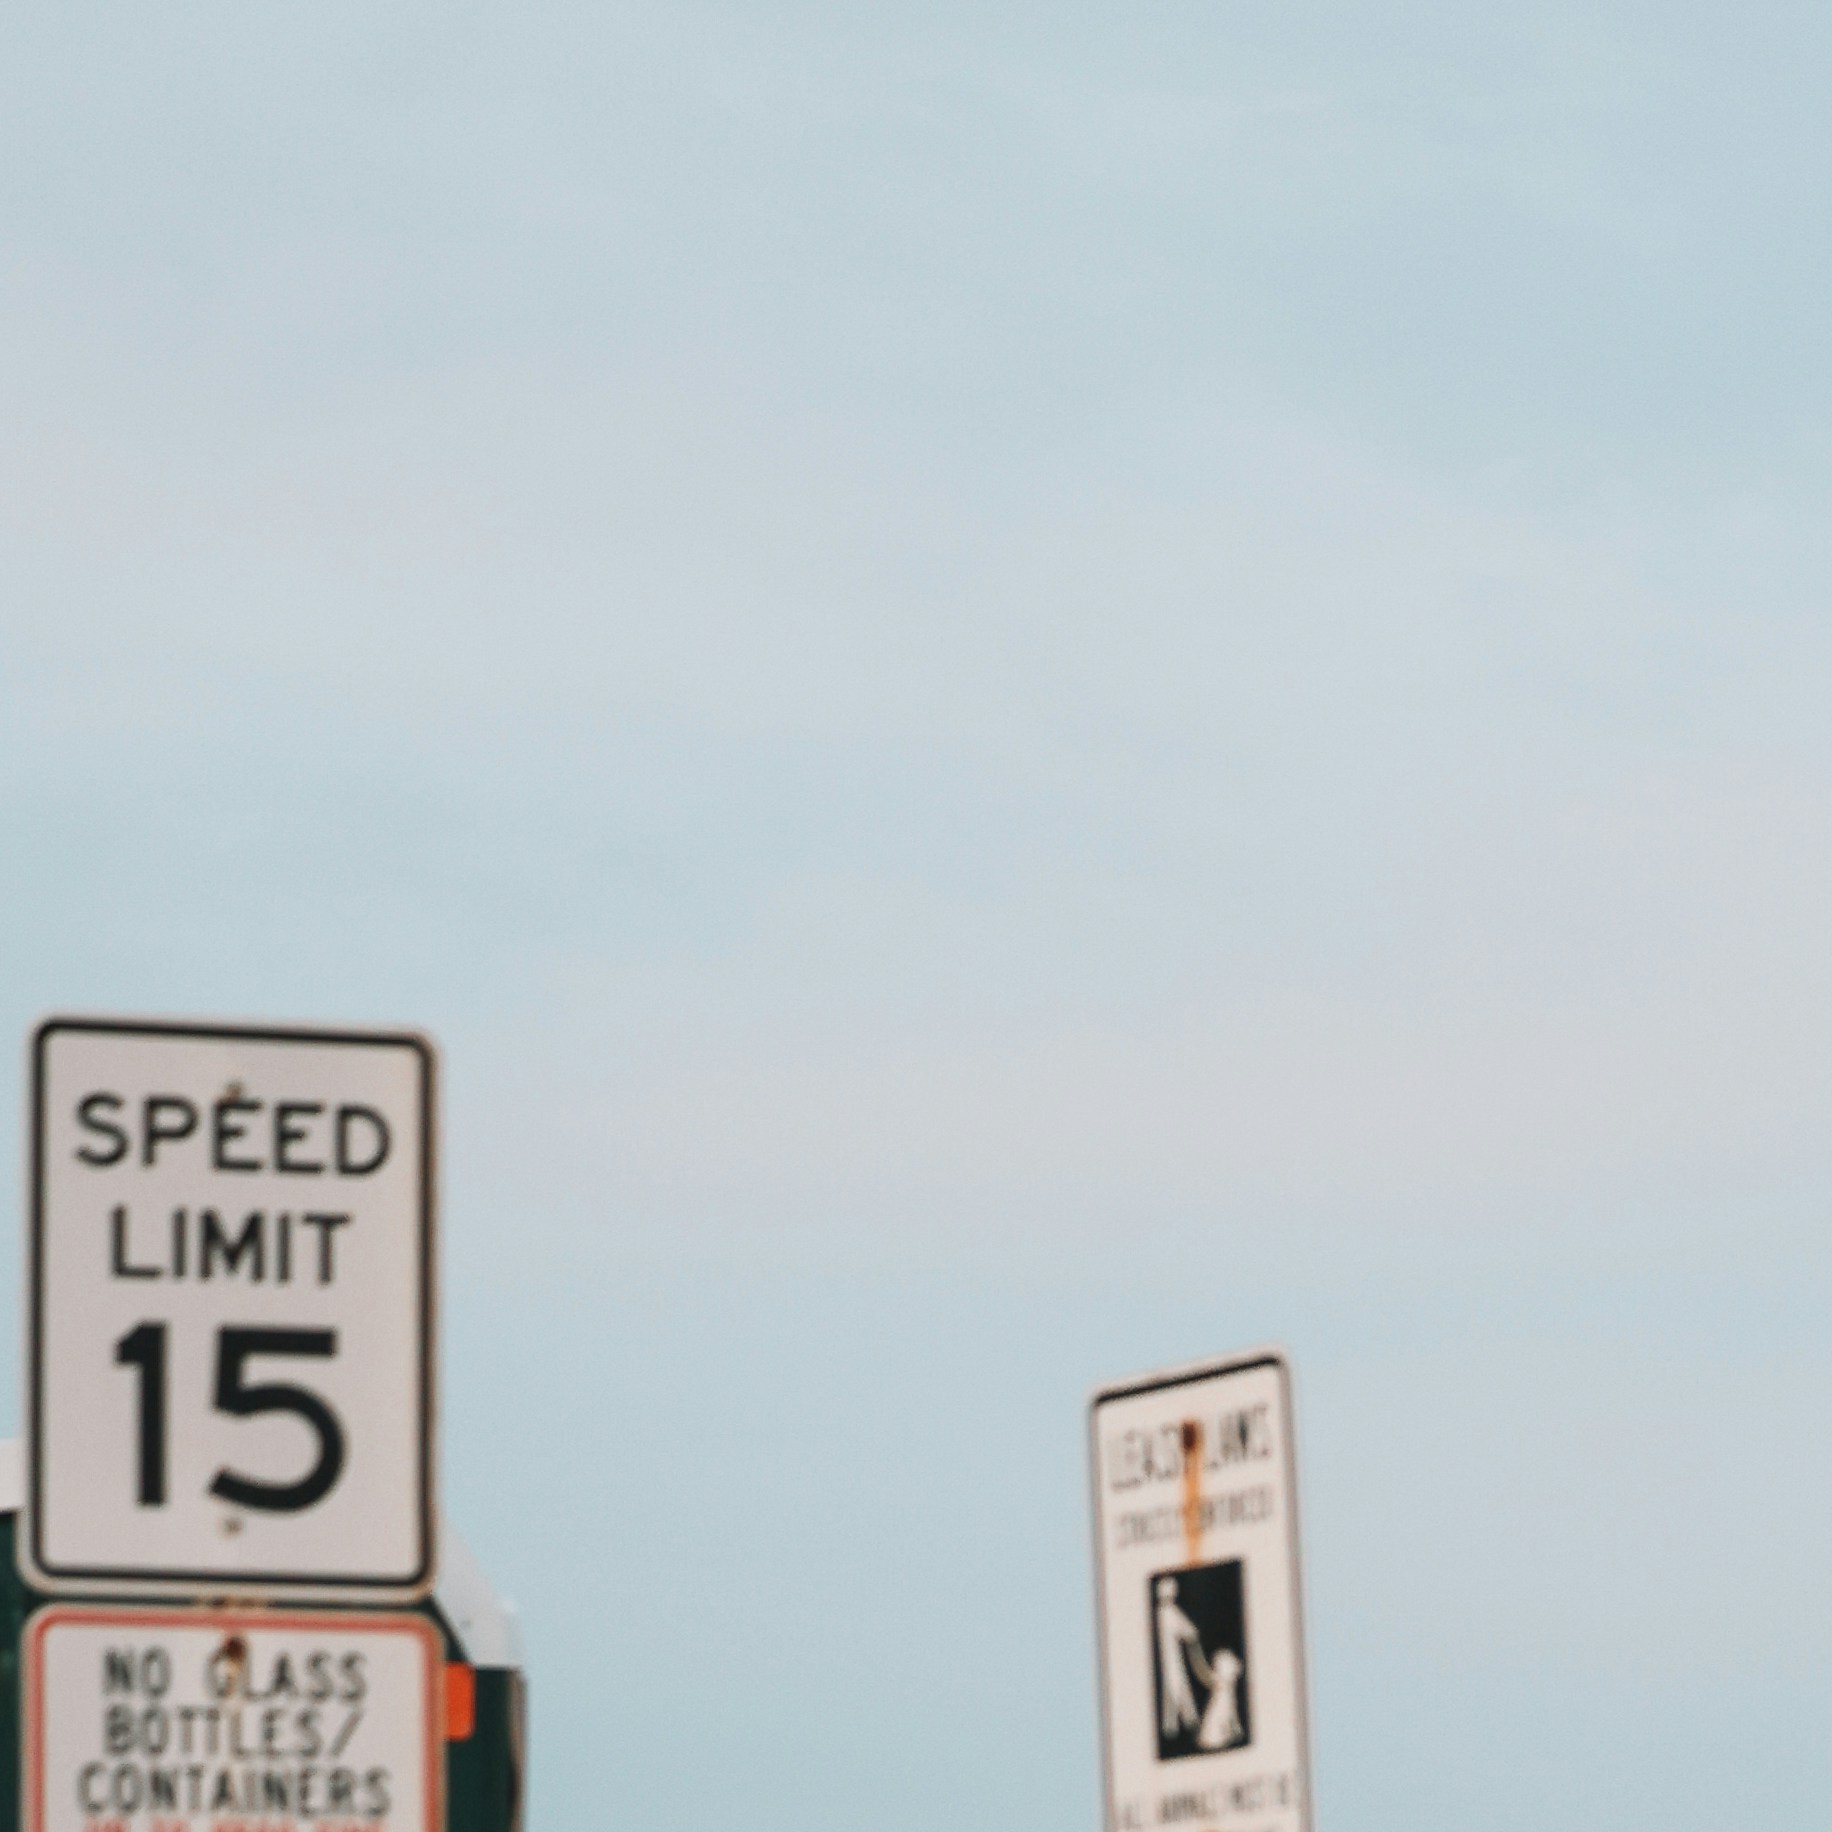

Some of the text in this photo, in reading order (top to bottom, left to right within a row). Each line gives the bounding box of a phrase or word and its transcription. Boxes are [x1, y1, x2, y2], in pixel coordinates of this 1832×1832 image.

[75, 1091, 393, 1176] SPEED
[110, 1204, 353, 1285] LIMIT
[115, 1319, 347, 1512] 15
[103, 1646, 369, 1704] NO GLASS
[105, 1704, 366, 1761] BOTTLES/
[78, 1762, 392, 1820] CONTAINERS
